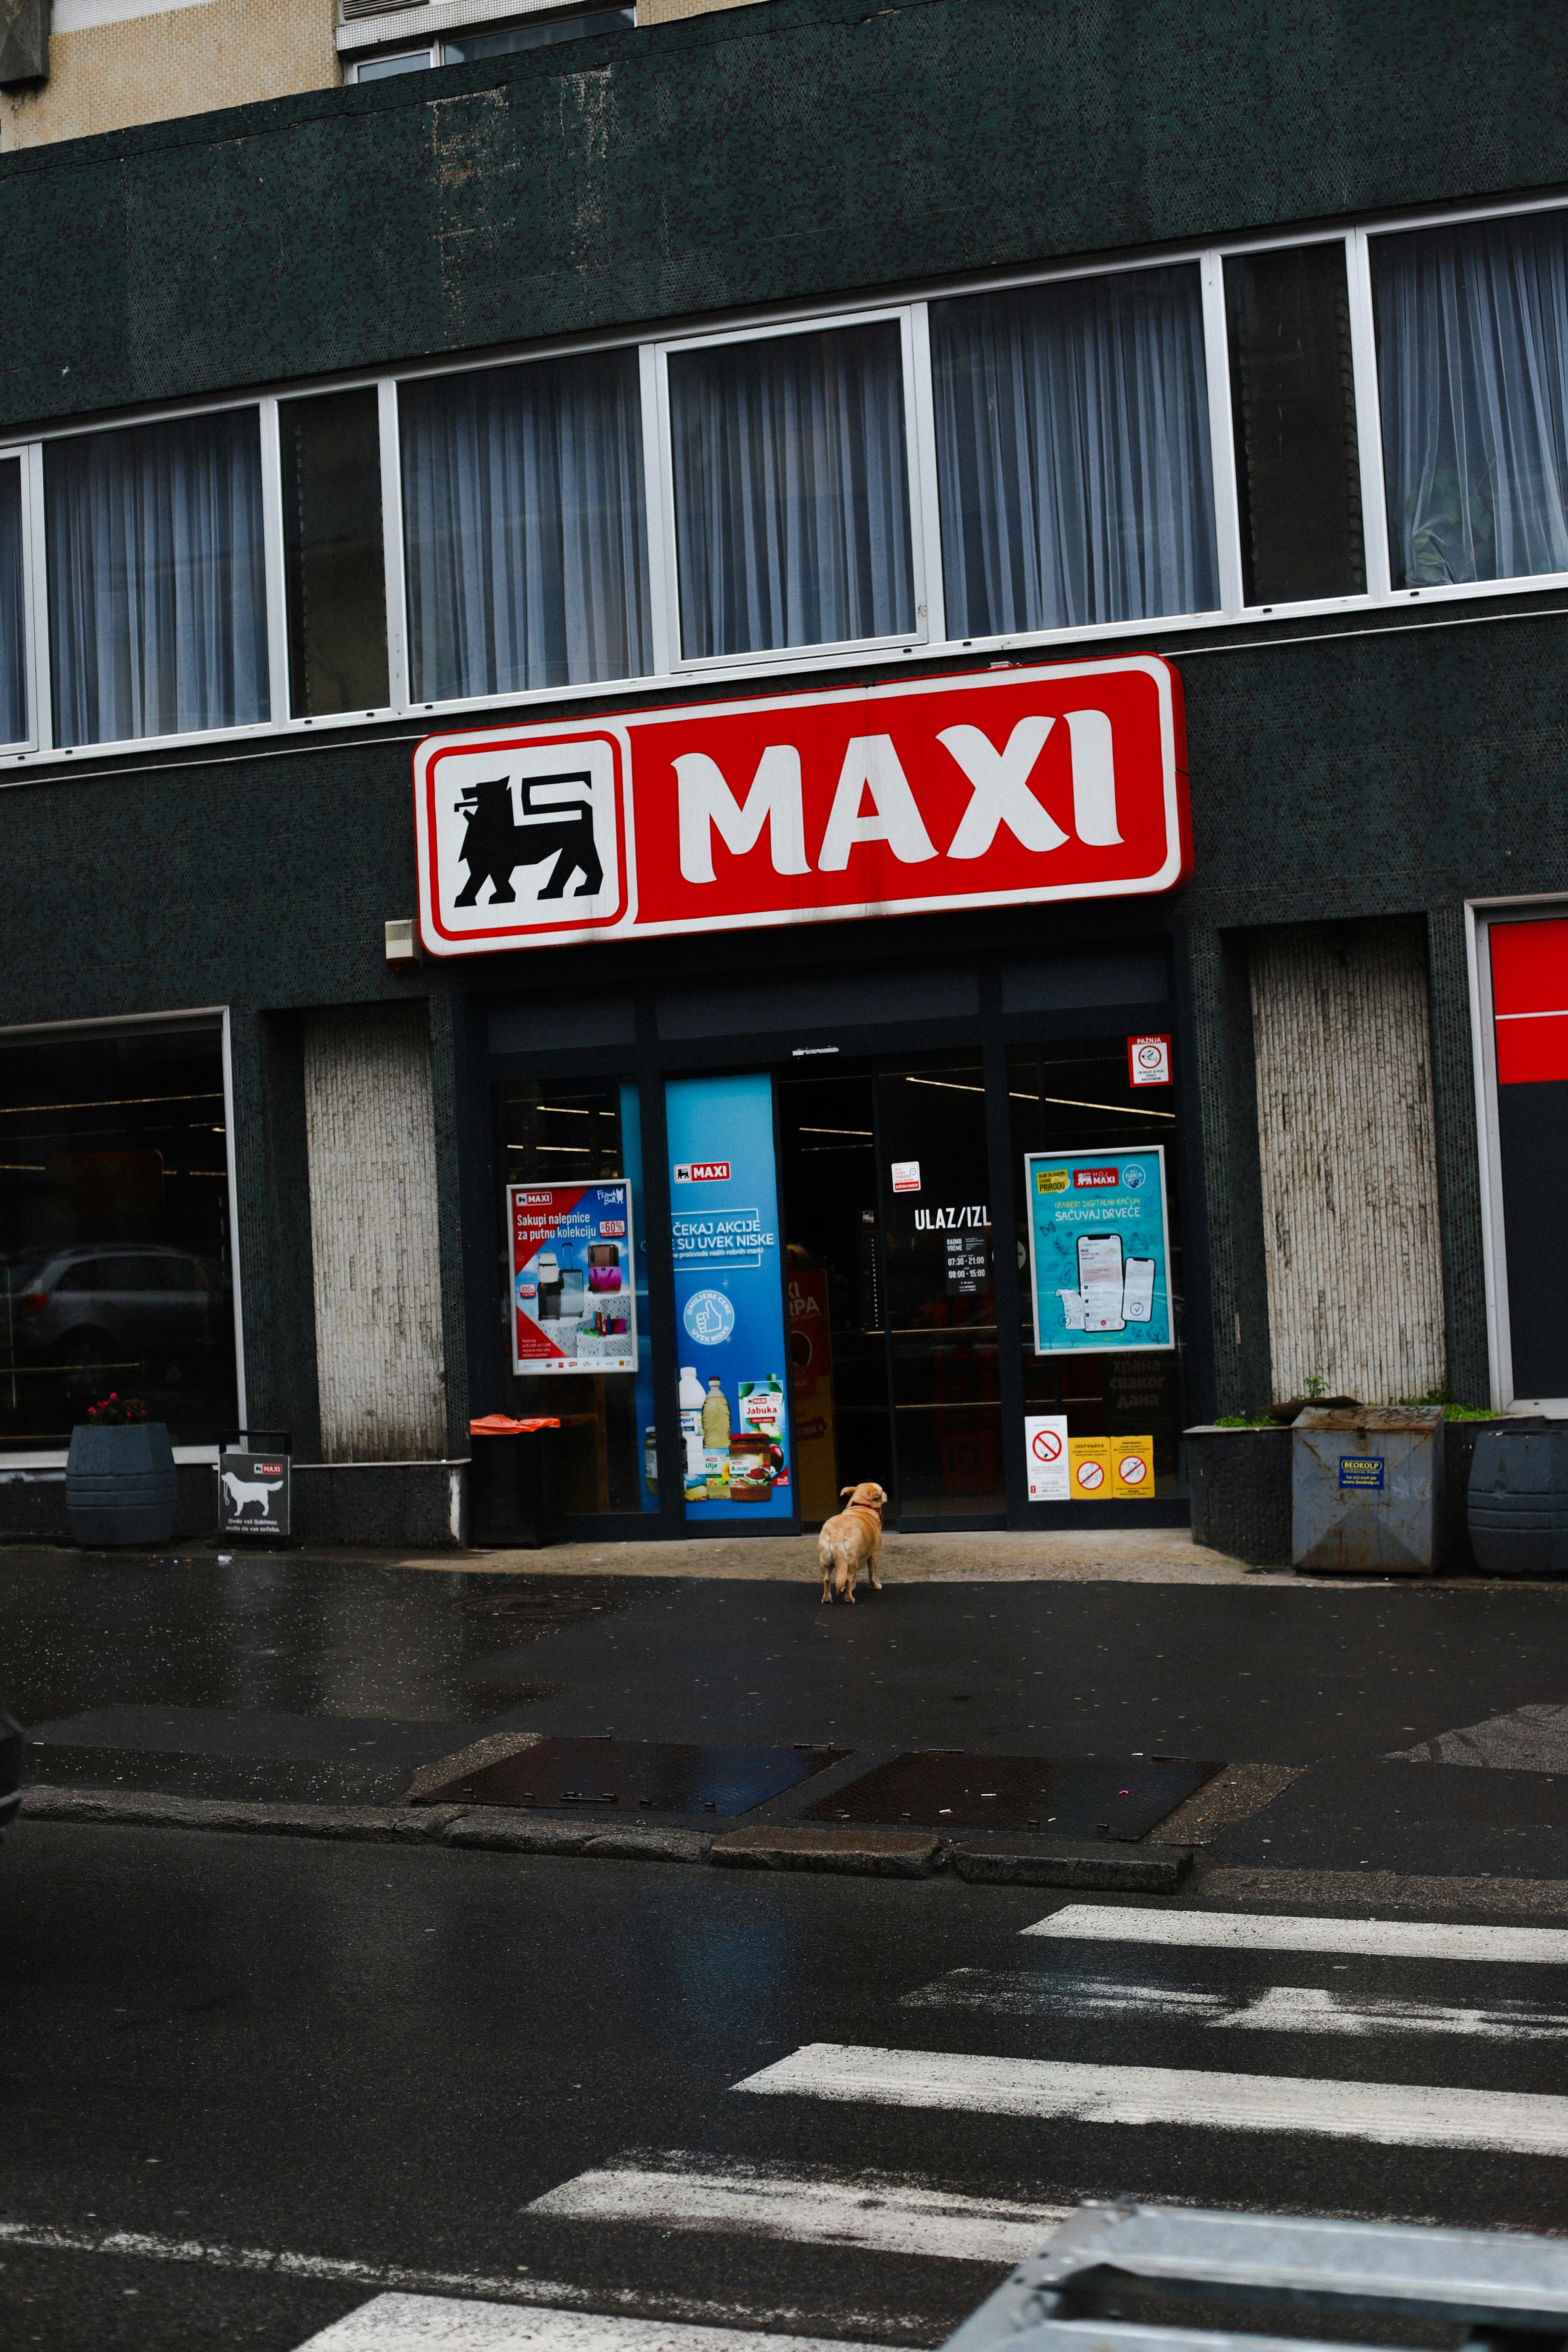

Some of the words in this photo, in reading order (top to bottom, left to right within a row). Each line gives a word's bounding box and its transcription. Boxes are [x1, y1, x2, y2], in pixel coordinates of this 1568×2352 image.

[671, 709, 1124, 884] MAXI
[693, 1165, 727, 1179] MAXI
[1040, 1182, 1065, 1191] PRIRODU
[1093, 1176, 1115, 1184] MAXI
[528, 1194, 549, 1203] MAXI
[1055, 1200, 1081, 1209] IZABERI
[1083, 1198, 1115, 1207] DIGITALNI
[1116, 1196, 1140, 1205] RAČUN
[518, 1214, 546, 1228] Sakupi
[549, 1212, 590, 1227] nalepnice
[1055, 1208, 1100, 1222] SAČUVAJ
[1102, 1205, 1140, 1219] DRVEĆE
[518, 1231, 528, 1240] za
[530, 1228, 555, 1242] putnu
[557, 1225, 596, 1239] kolekciju
[673, 1222, 713, 1236] ČEKAJ
[716, 1220, 761, 1234] AKCIJE
[678, 1237, 694, 1250] SU
[698, 1235, 733, 1249] UVEK
[737, 1233, 774, 1246] NISKE
[680, 1250, 708, 1259] proizvode
[948, 1257, 964, 1266] 07:30
[969, 1256, 984, 1265] 21:00
[948, 1270, 965, 1279] 08:00
[969, 1269, 985, 1277] 15:00
[687, 1293, 717, 1315] OMILJENE
[718, 1297, 732, 1315] CENE
[691, 1329, 709, 1342] UVEK
[710, 1325, 730, 1342] NISKE
[746, 1406, 777, 1415] Jabuka
